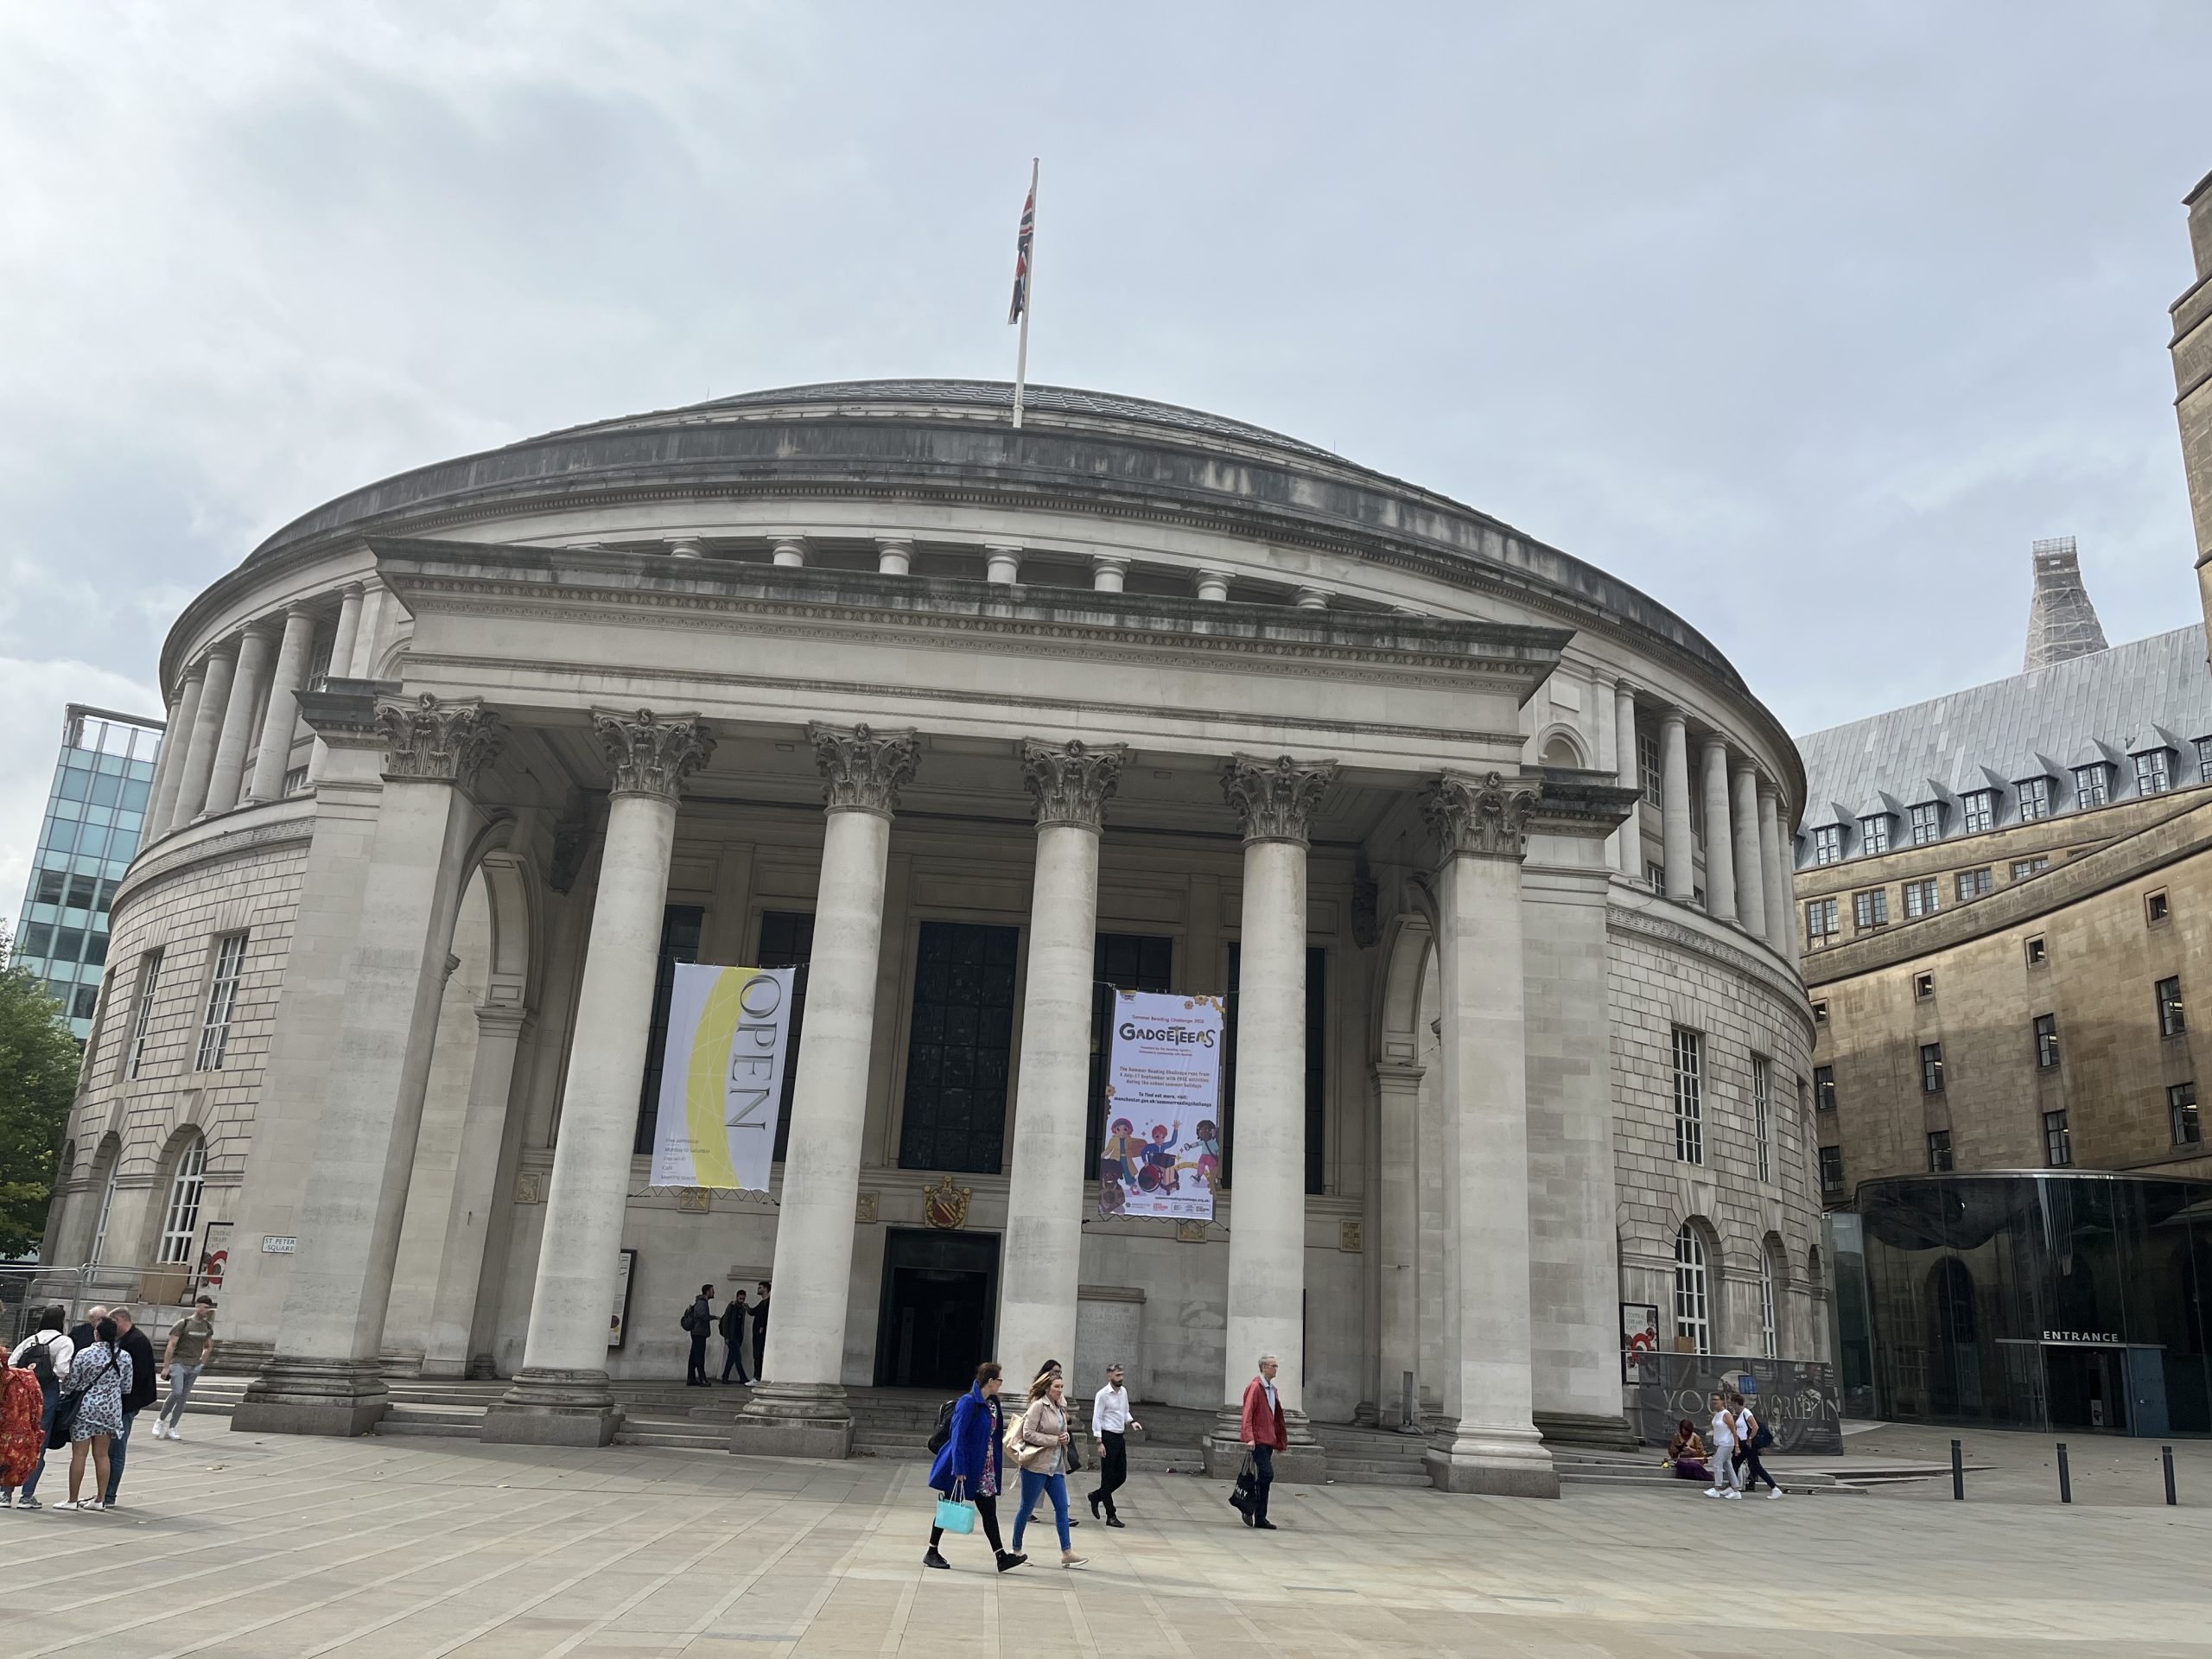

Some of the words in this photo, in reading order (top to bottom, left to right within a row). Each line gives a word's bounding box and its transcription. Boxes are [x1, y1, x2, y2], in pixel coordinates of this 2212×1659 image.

[1119, 1022, 1216, 1048] GADGETEERS
[725, 975, 781, 1130] OPEN
[2043, 1331, 2119, 1342] ENTRANCE
[1662, 1389, 1729, 1414] YOU
[1757, 1393, 1816, 1420] WORLD
